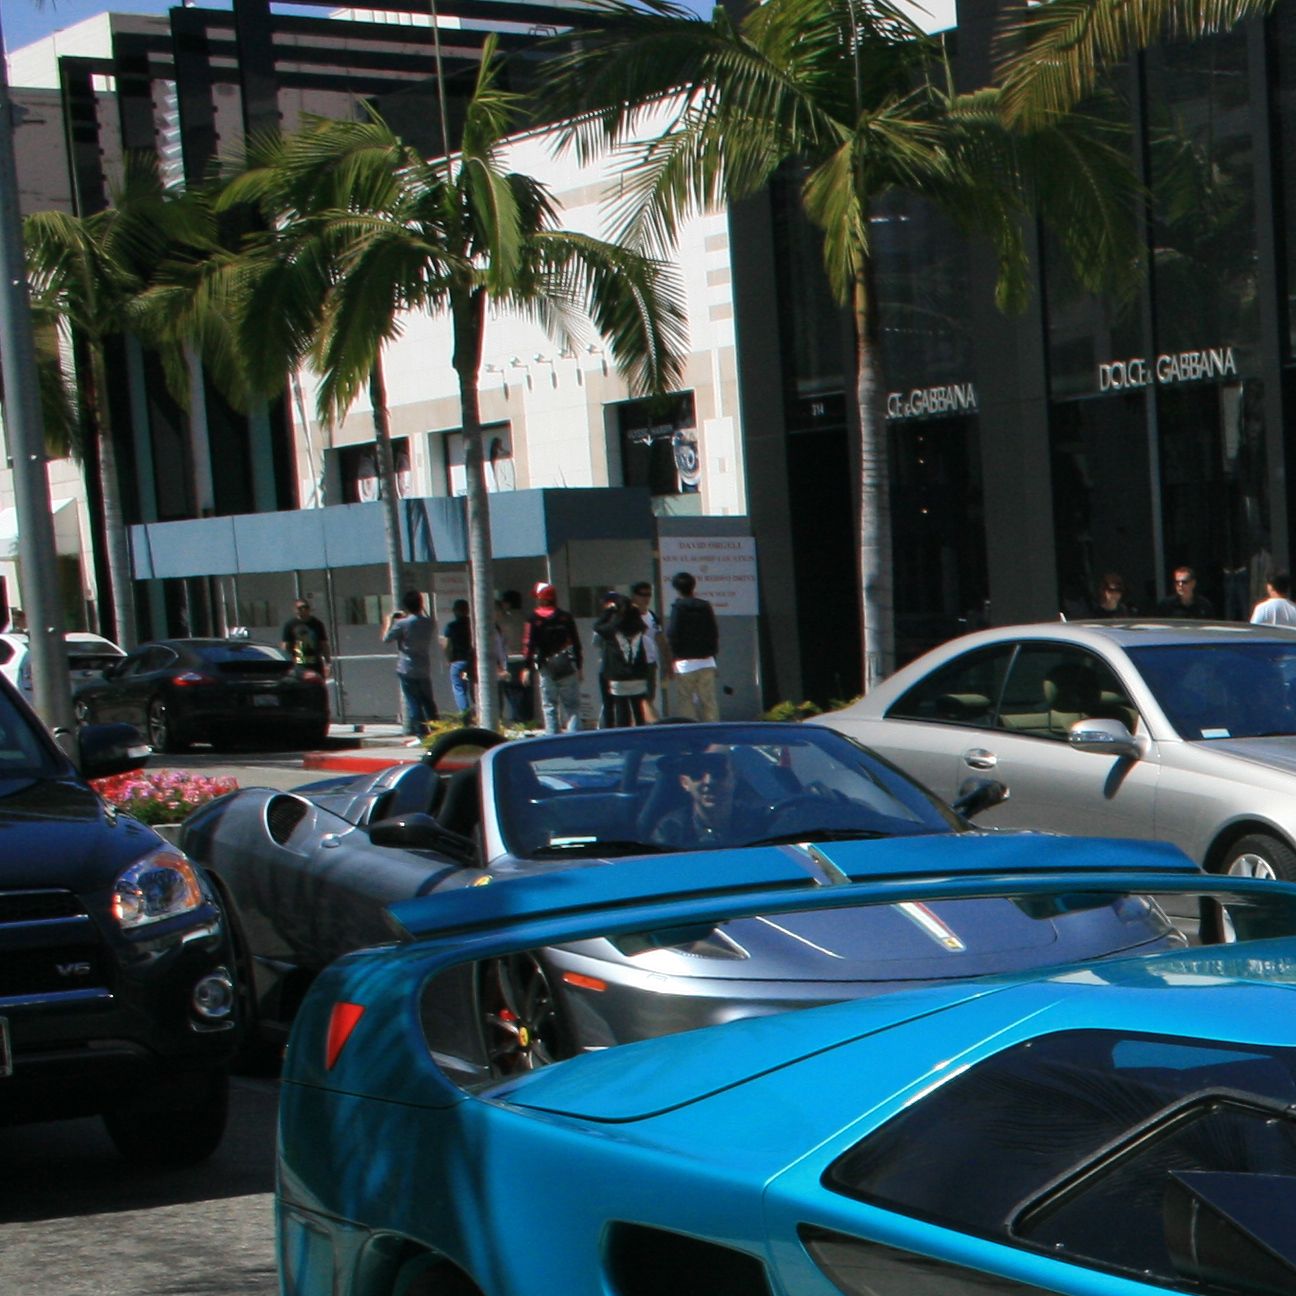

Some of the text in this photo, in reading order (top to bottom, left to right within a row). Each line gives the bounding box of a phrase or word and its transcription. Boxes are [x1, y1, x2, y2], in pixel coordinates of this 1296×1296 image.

[1100, 358, 1146, 391] DOLCE
[1156, 346, 1237, 384] GABBANA
[910, 383, 977, 416] GABBANA
[56, 961, 91, 976] V6
